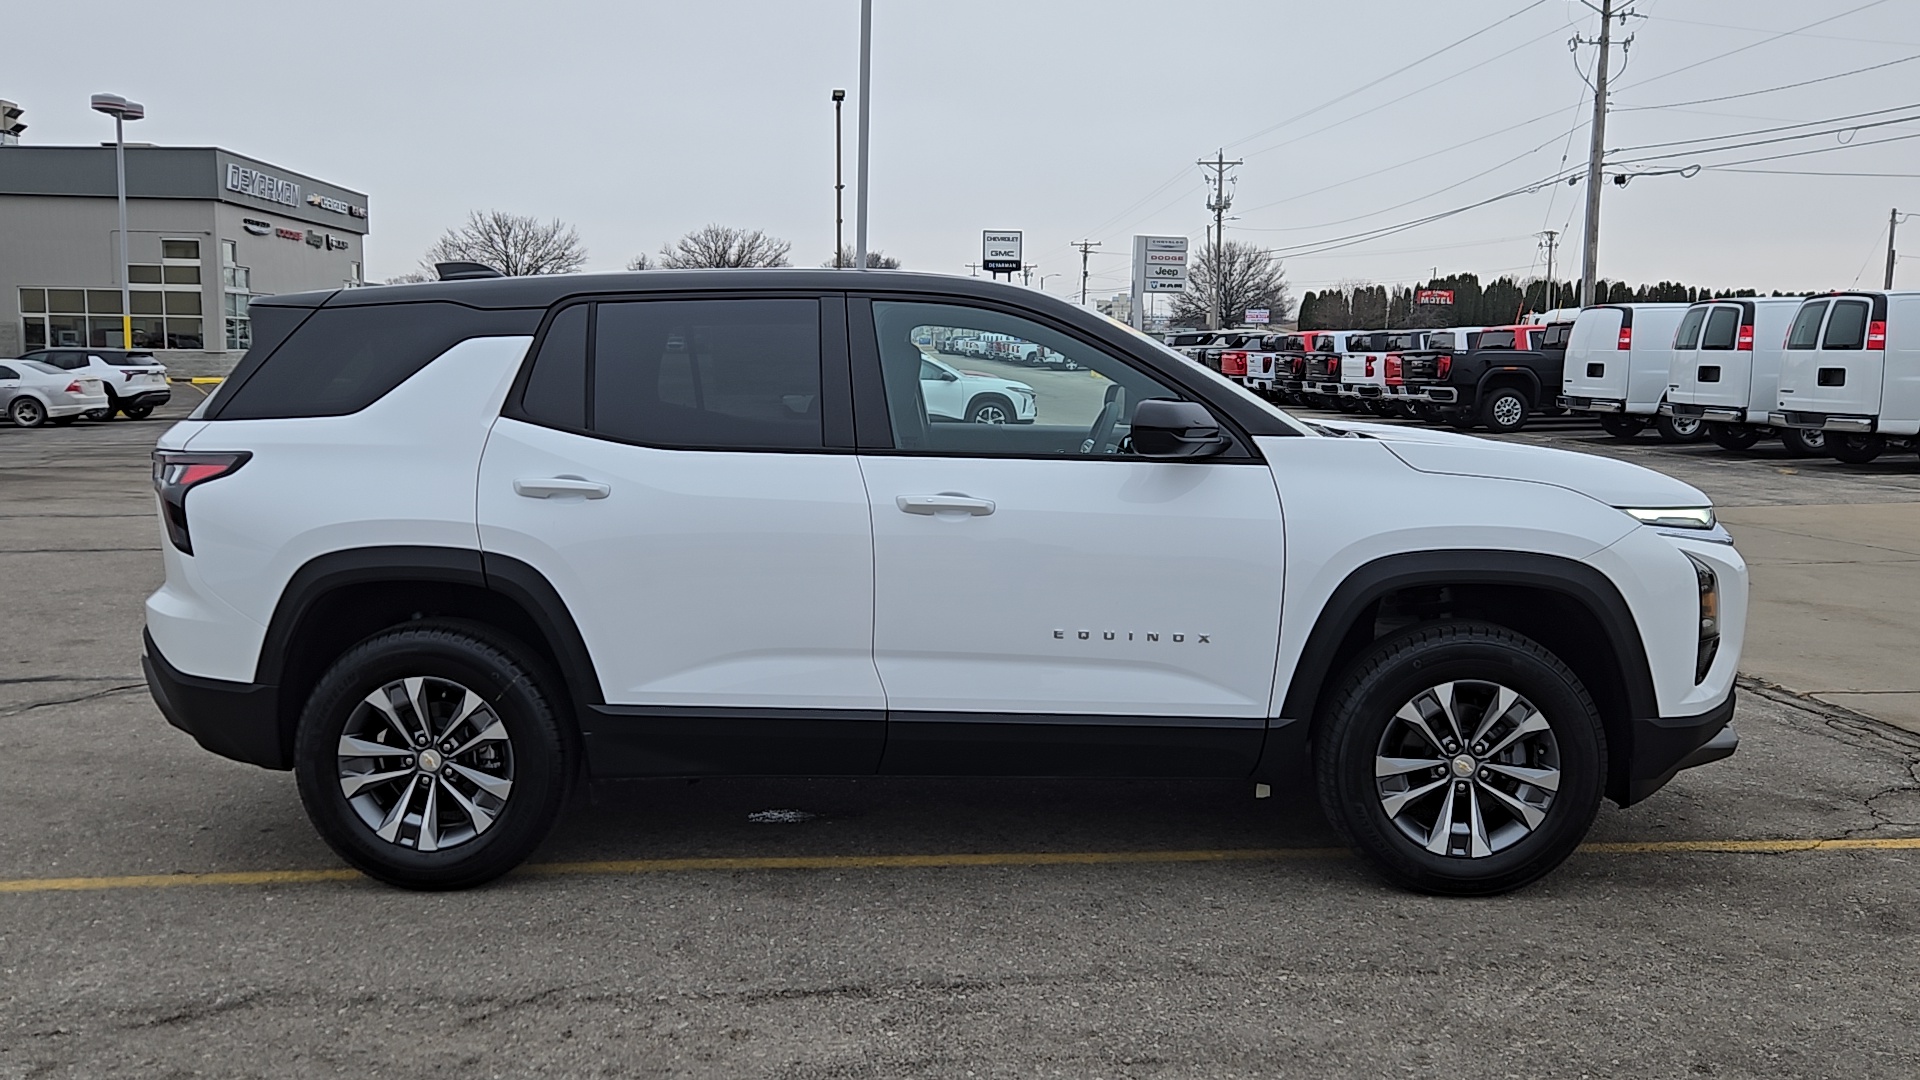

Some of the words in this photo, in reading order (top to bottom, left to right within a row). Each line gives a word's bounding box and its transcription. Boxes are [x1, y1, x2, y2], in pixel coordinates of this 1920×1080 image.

[986, 235, 1019, 243] CHEVROLET
[1155, 266, 1179, 277] Jeep
[1420, 297, 1452, 305] MOTEL
[1053, 629, 1211, 644] EQUINOX
